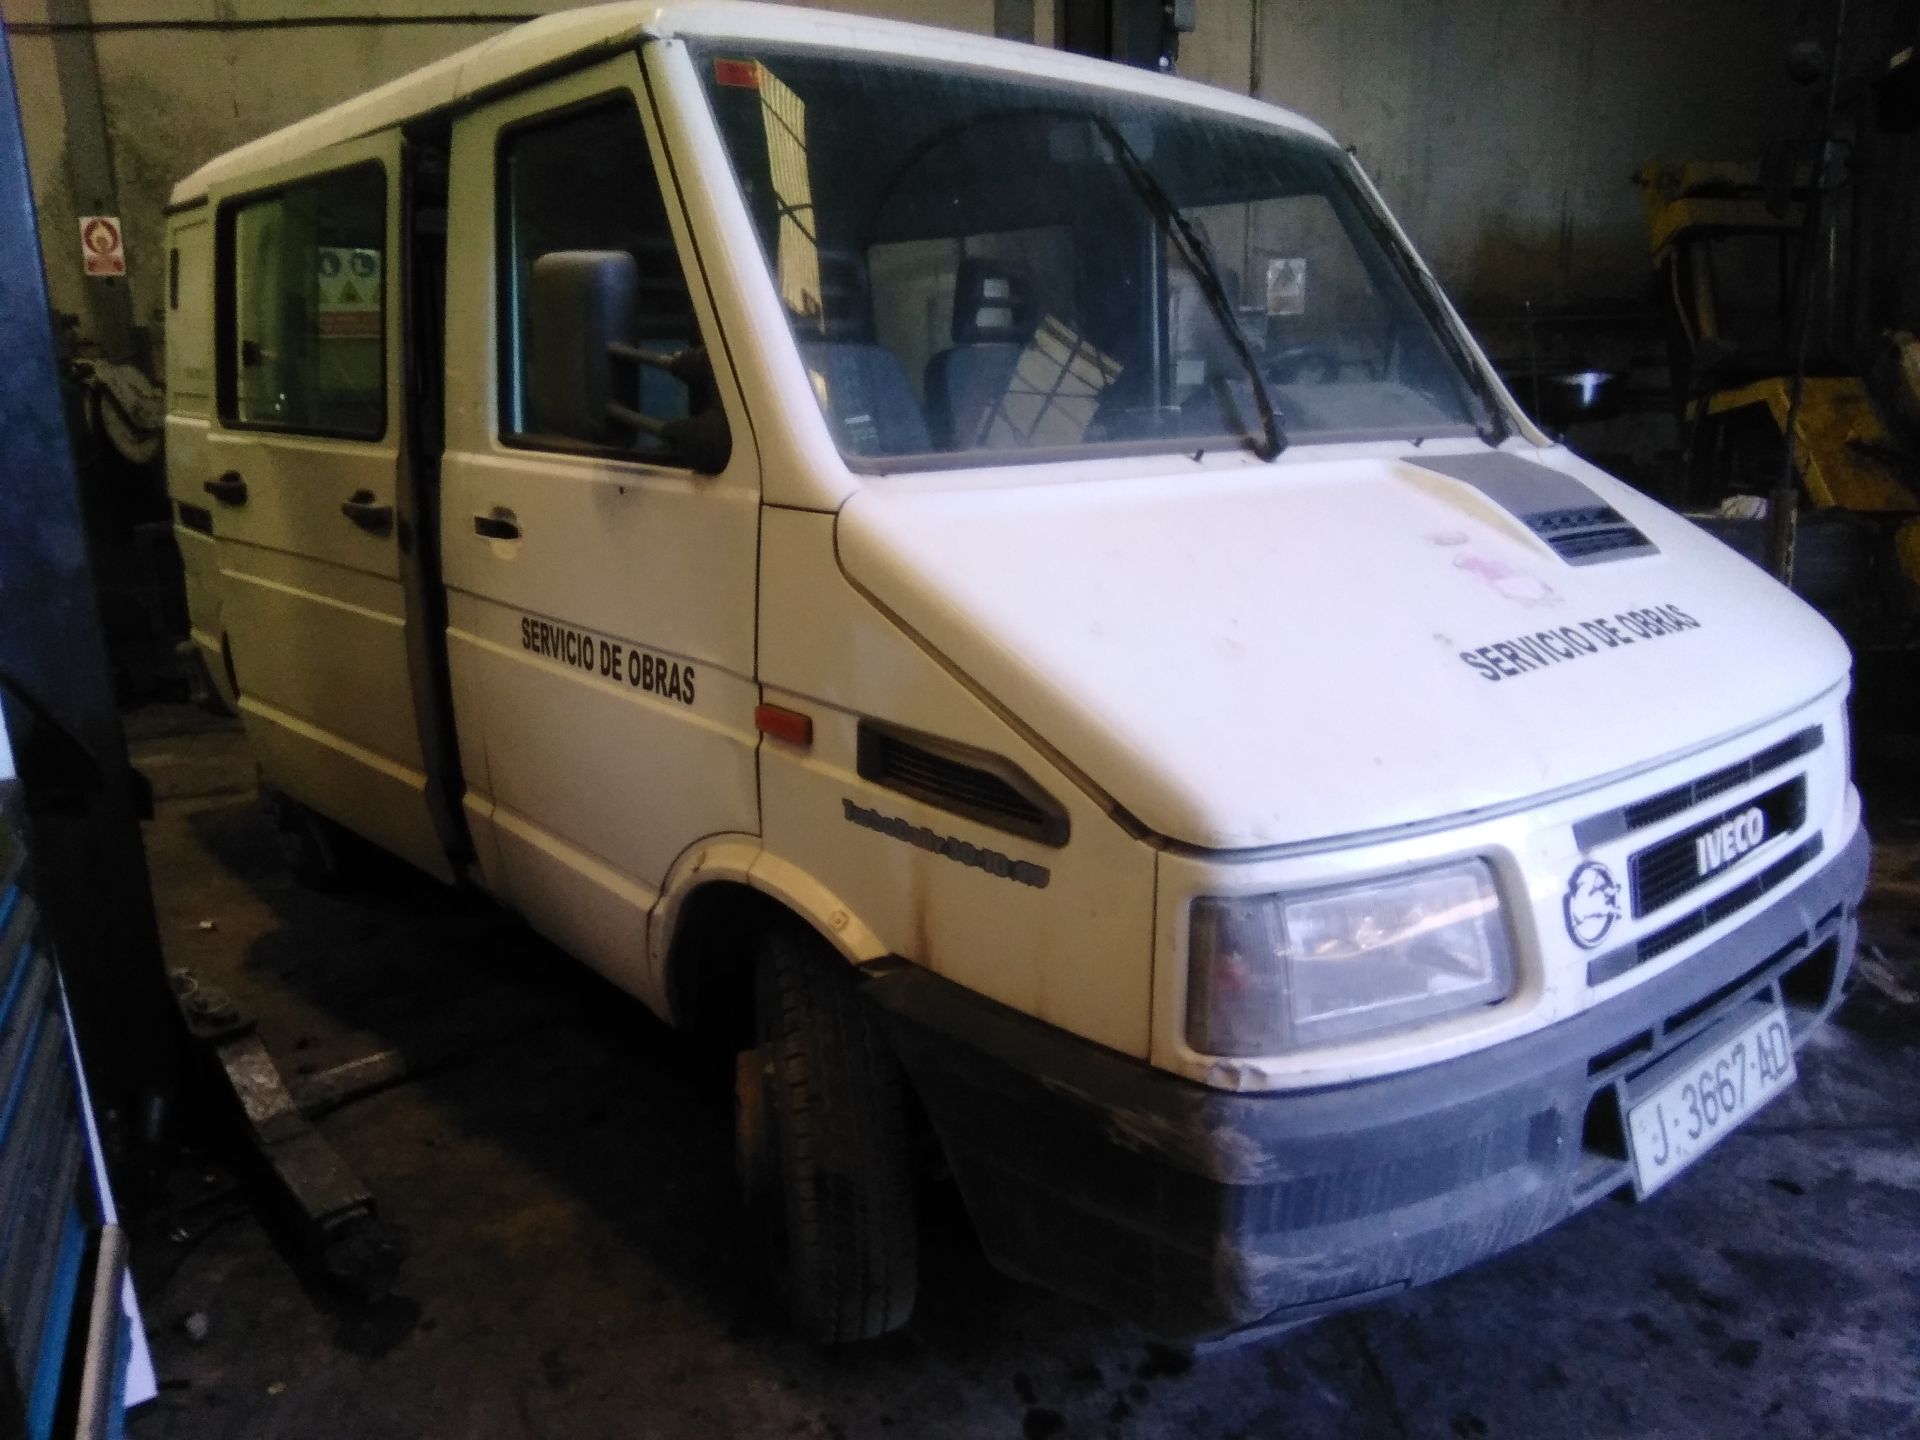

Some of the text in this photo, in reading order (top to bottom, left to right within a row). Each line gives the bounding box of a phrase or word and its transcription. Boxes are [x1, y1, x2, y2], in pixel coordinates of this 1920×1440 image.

[521, 616, 695, 705] SERVICIO DE OBRAS
[1459, 603, 1701, 681] SERVICIO DE OBRAS
[1695, 806, 1764, 876] IVECO
